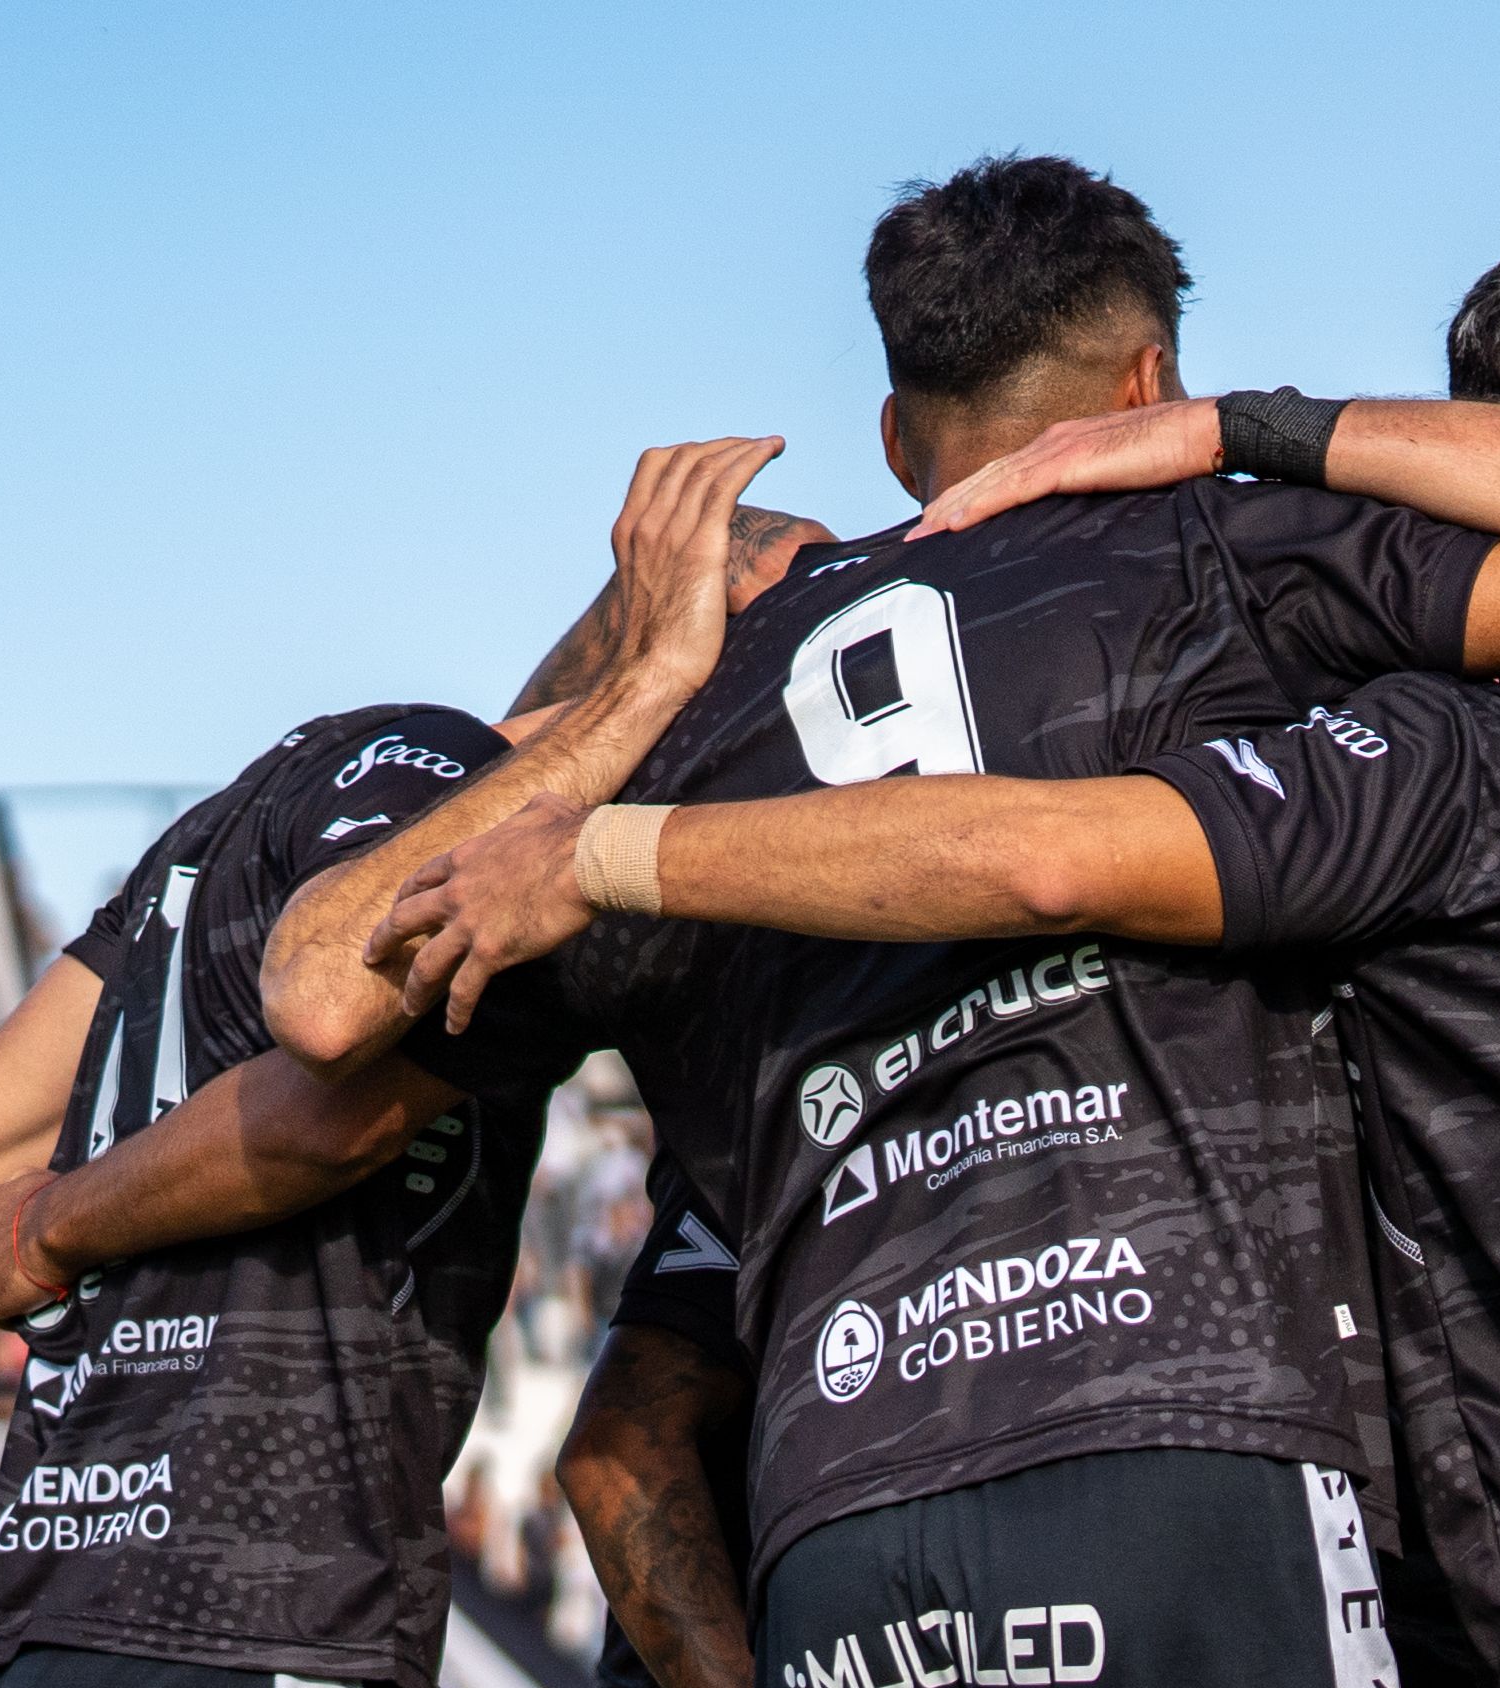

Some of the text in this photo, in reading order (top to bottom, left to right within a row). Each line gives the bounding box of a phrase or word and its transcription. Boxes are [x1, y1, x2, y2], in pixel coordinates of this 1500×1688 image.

[785, 579, 985, 785] 9
[335, 735, 465, 789] Secco
[886, 1080, 1128, 1183] Montemar
[927, 1122, 1125, 1192] Compañía Financiera S.A.
[897, 1236, 1146, 1336] MENDOZA
[900, 1287, 1154, 1383] GOBIERNO
